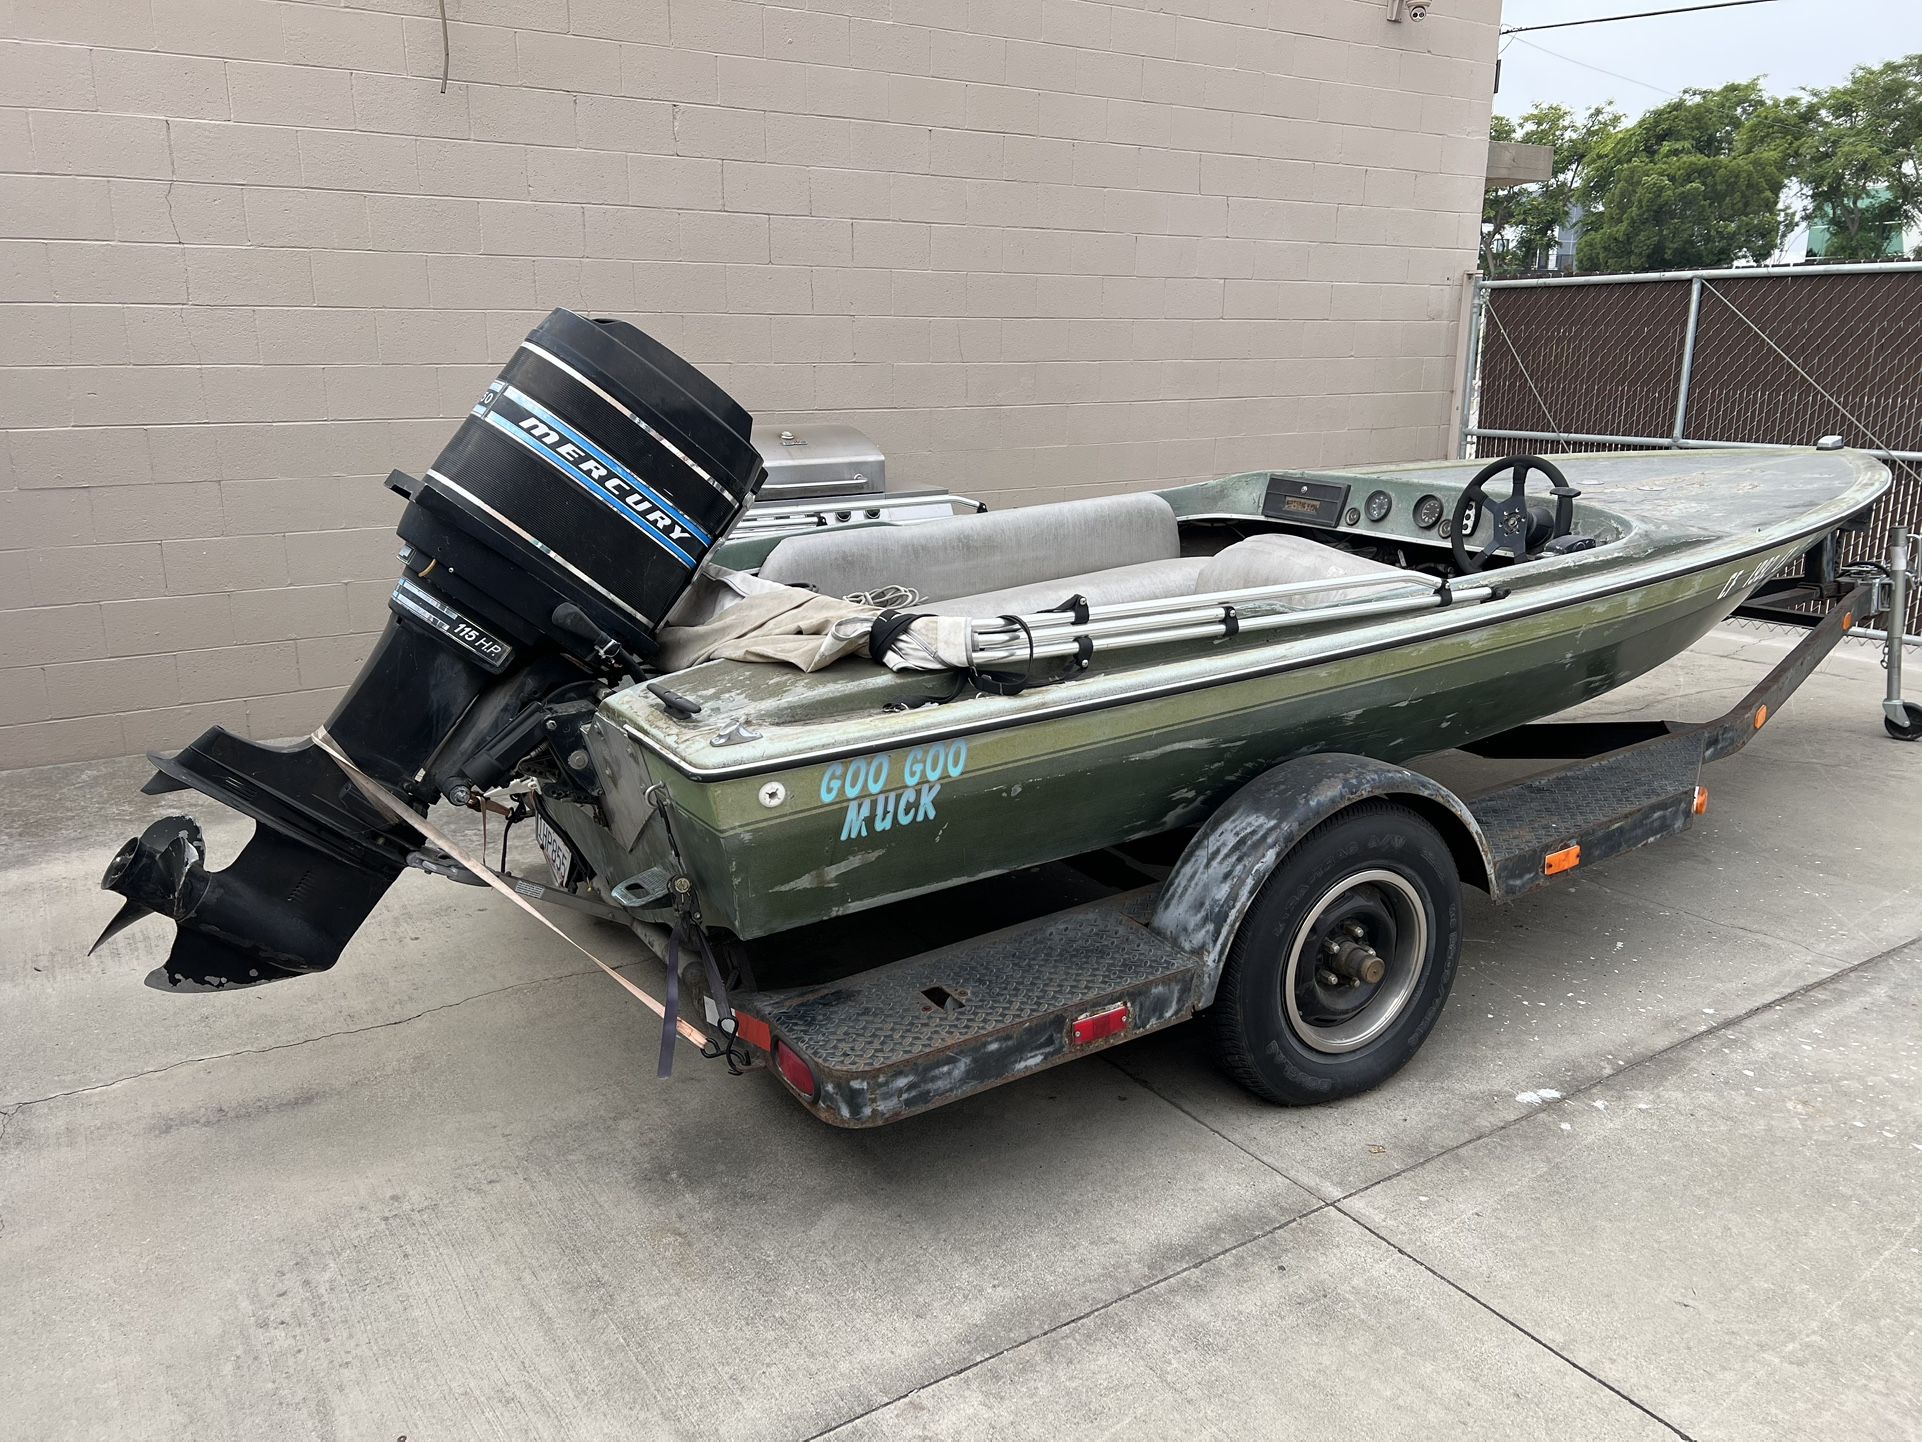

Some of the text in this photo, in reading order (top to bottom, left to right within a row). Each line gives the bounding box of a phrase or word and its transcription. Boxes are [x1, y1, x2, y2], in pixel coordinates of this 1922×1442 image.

[517, 417, 692, 541] MERCURY
[454, 623, 480, 641] 115
[819, 738, 968, 804] GOO GOO
[840, 783, 942, 841] MUCK
